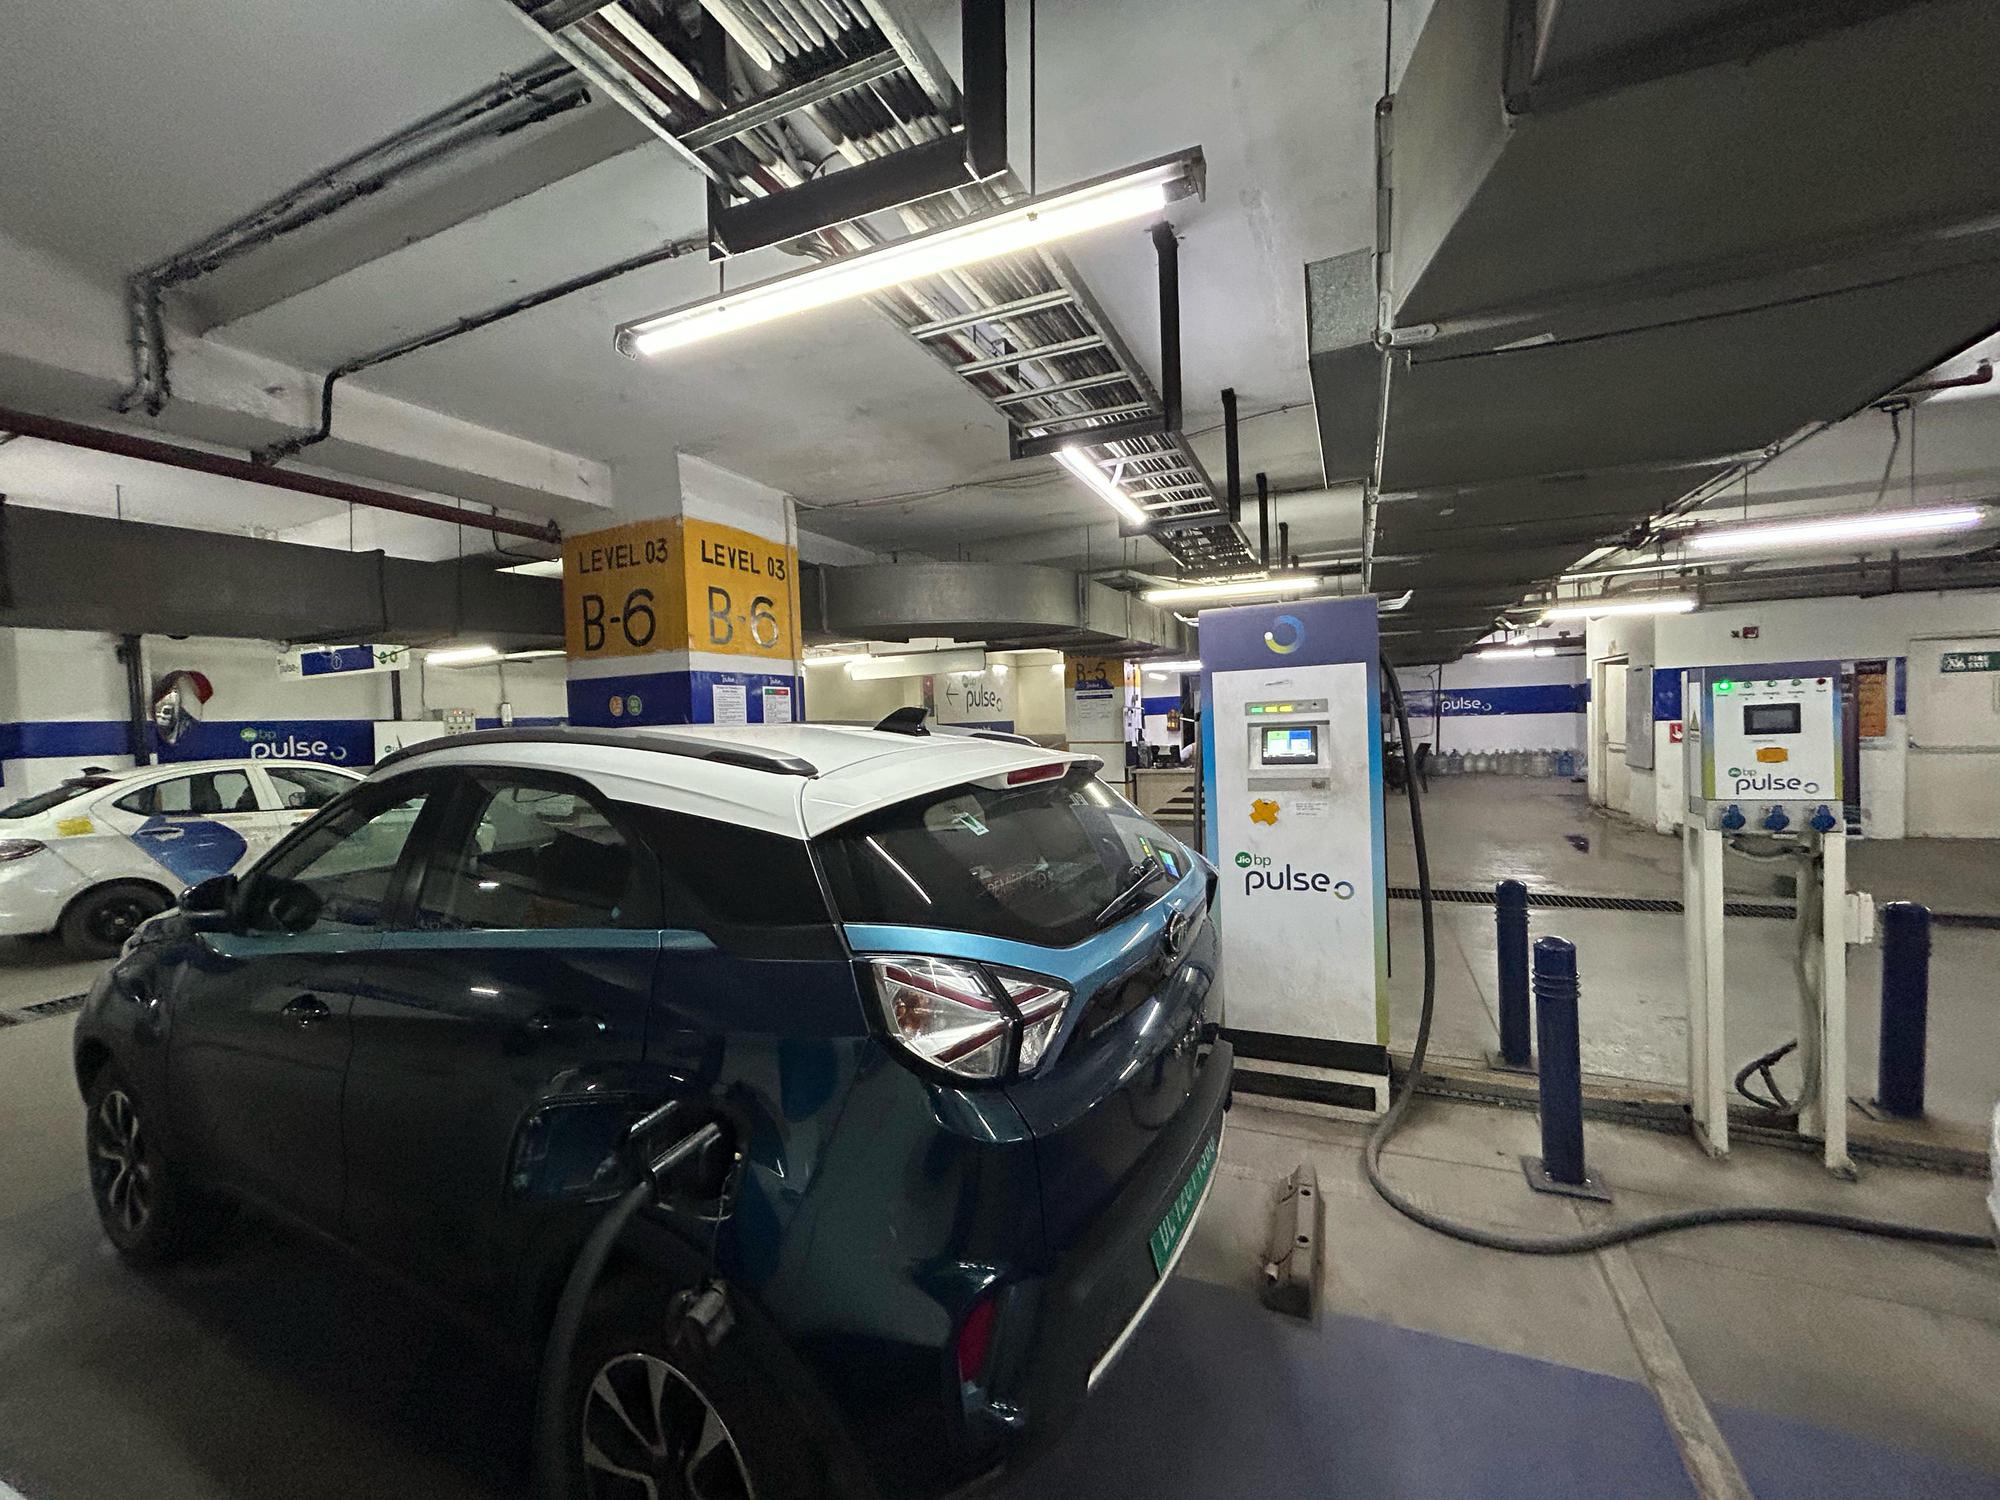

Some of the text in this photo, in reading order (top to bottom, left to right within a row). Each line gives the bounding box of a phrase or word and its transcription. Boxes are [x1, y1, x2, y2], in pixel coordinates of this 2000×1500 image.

[579, 537, 668, 574] LEVEL 03
[701, 538, 785, 581] LEVEL 03
[582, 587, 656, 651] B-6
[708, 585, 779, 649] B-6
[966, 683, 995, 714] pulse
[1441, 696, 1481, 713] pulse
[250, 735, 328, 759] pulse
[1735, 773, 1801, 795] pulse
[1236, 854, 1272, 868] Jio bp
[1245, 864, 1330, 896] pulse
